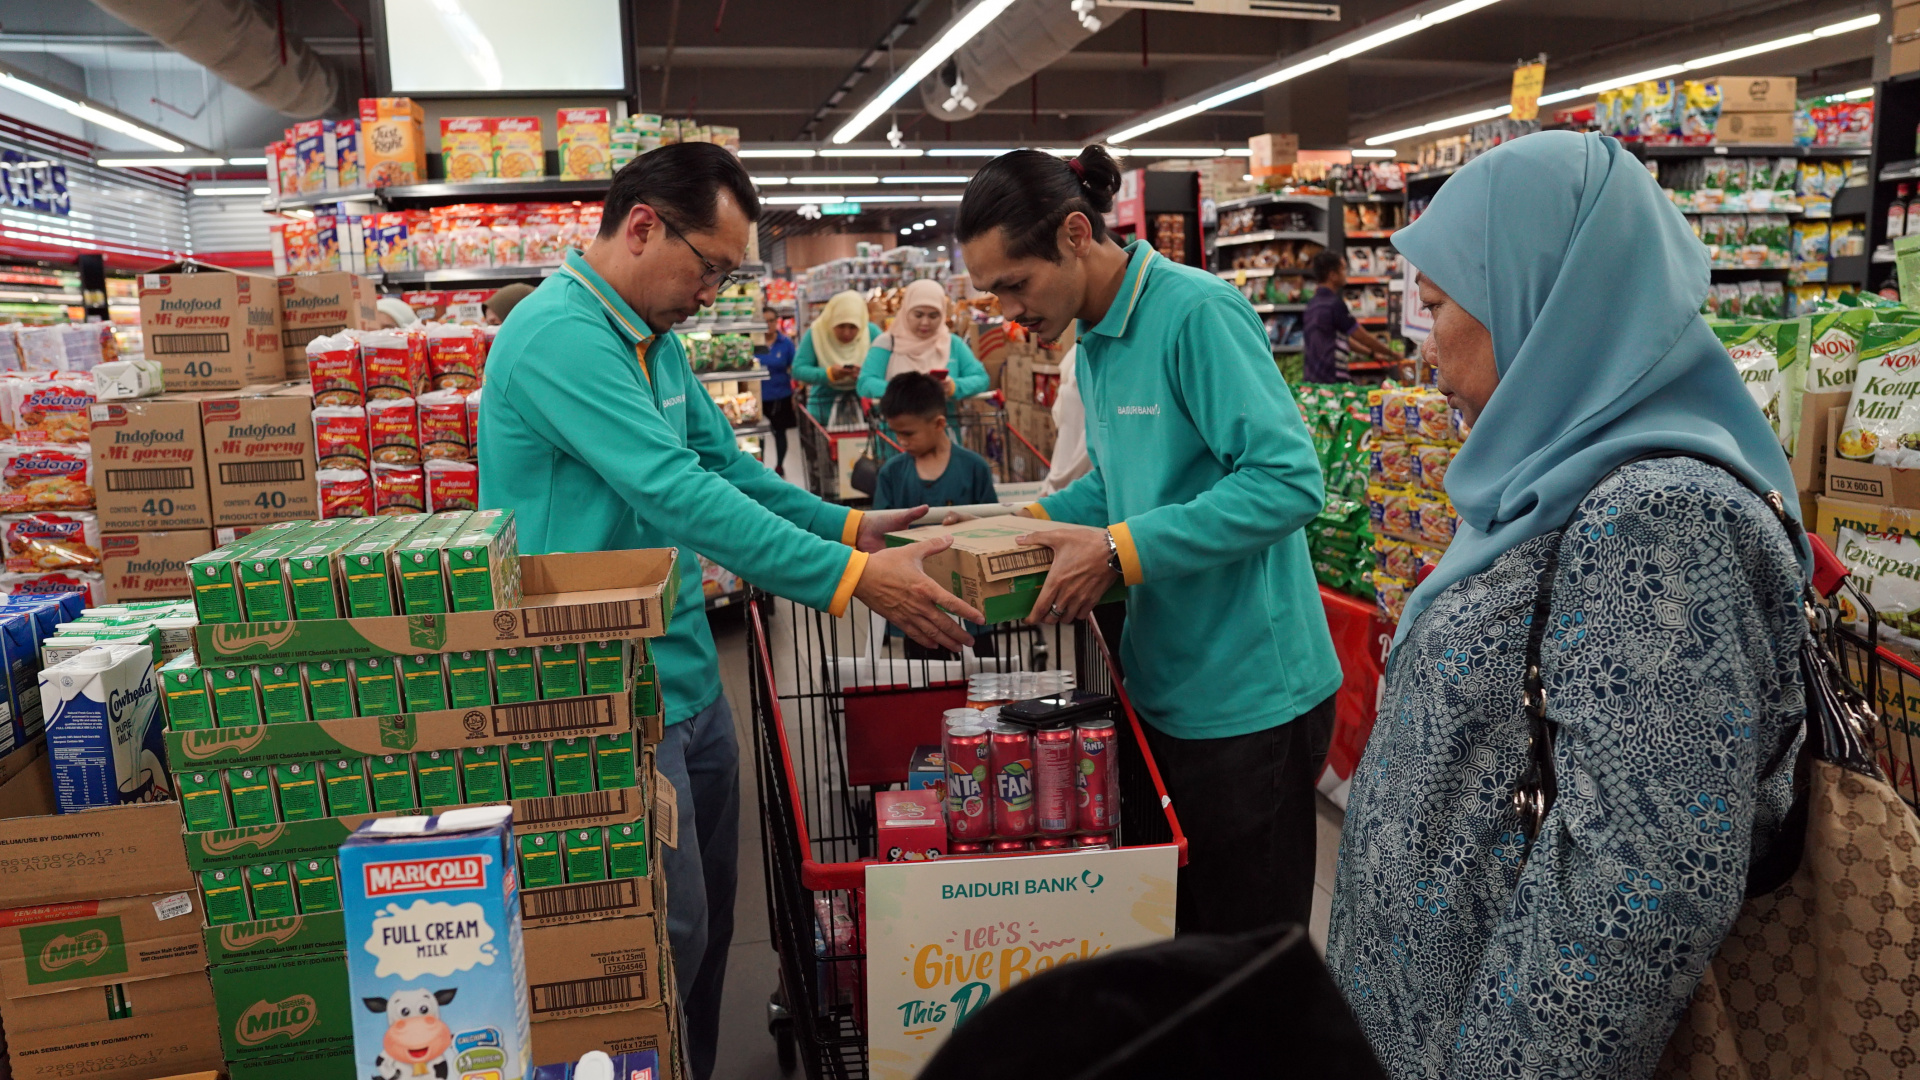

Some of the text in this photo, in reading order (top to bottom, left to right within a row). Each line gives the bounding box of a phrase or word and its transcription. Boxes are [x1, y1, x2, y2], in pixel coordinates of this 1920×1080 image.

[160, 298, 222, 312] Indofood
[286, 295, 339, 309] Indofood
[148, 313, 230, 328] Mi goreng
[1880, 353, 1920, 367] NON
[184, 361, 212, 377] 40
[1853, 399, 1904, 419] Mini
[115, 429, 184, 446] Indofood
[228, 423, 296, 441] Indofood
[101, 446, 194, 463] Mi goreng
[214, 441, 304, 458] Mi goreng
[15, 457, 83, 473] Sedaap
[1835, 479, 1877, 492] 18 X 600 G
[142, 499, 174, 516] 40
[255, 491, 286, 509] 40
[105, 520, 144, 528] PRODUCT
[220, 513, 256, 522] PRODUCT
[273, 510, 316, 519] INDONESIA
[15, 520, 83, 535] Sedaap
[127, 558, 186, 575] Indofoo
[309, 649, 338, 657] Chocolate
[109, 677, 153, 722] Cowhead
[115, 718, 132, 735] PURE
[117, 730, 133, 746] MILK
[1083, 741, 1105, 752] FANTA
[950, 774, 981, 796] NTA
[997, 774, 1032, 798] FAN
[40, 836, 49, 844] BY
[1, 857, 106, 874] 13 AUG 2023
[370, 862, 479, 892] MARIGOLD
[942, 876, 1078, 899] BAIDURI BANK
[383, 920, 479, 946] FULL CREAM
[49, 940, 103, 962] MILO
[416, 944, 448, 958] MILK
[598, 956, 607, 964] 10
[608, 955, 615, 963] (4
[622, 952, 646, 961] 125ml)
[608, 962, 643, 973] 12504546
[913, 944, 993, 990] Give
[247, 1006, 310, 1035] MILO
[897, 1000, 947, 1028] This
[19, 1049, 39, 1057] GUNA
[90, 1040, 100, 1048] BY
[621, 1043, 627, 1051] (4
[634, 1039, 658, 1049] 125ml)
